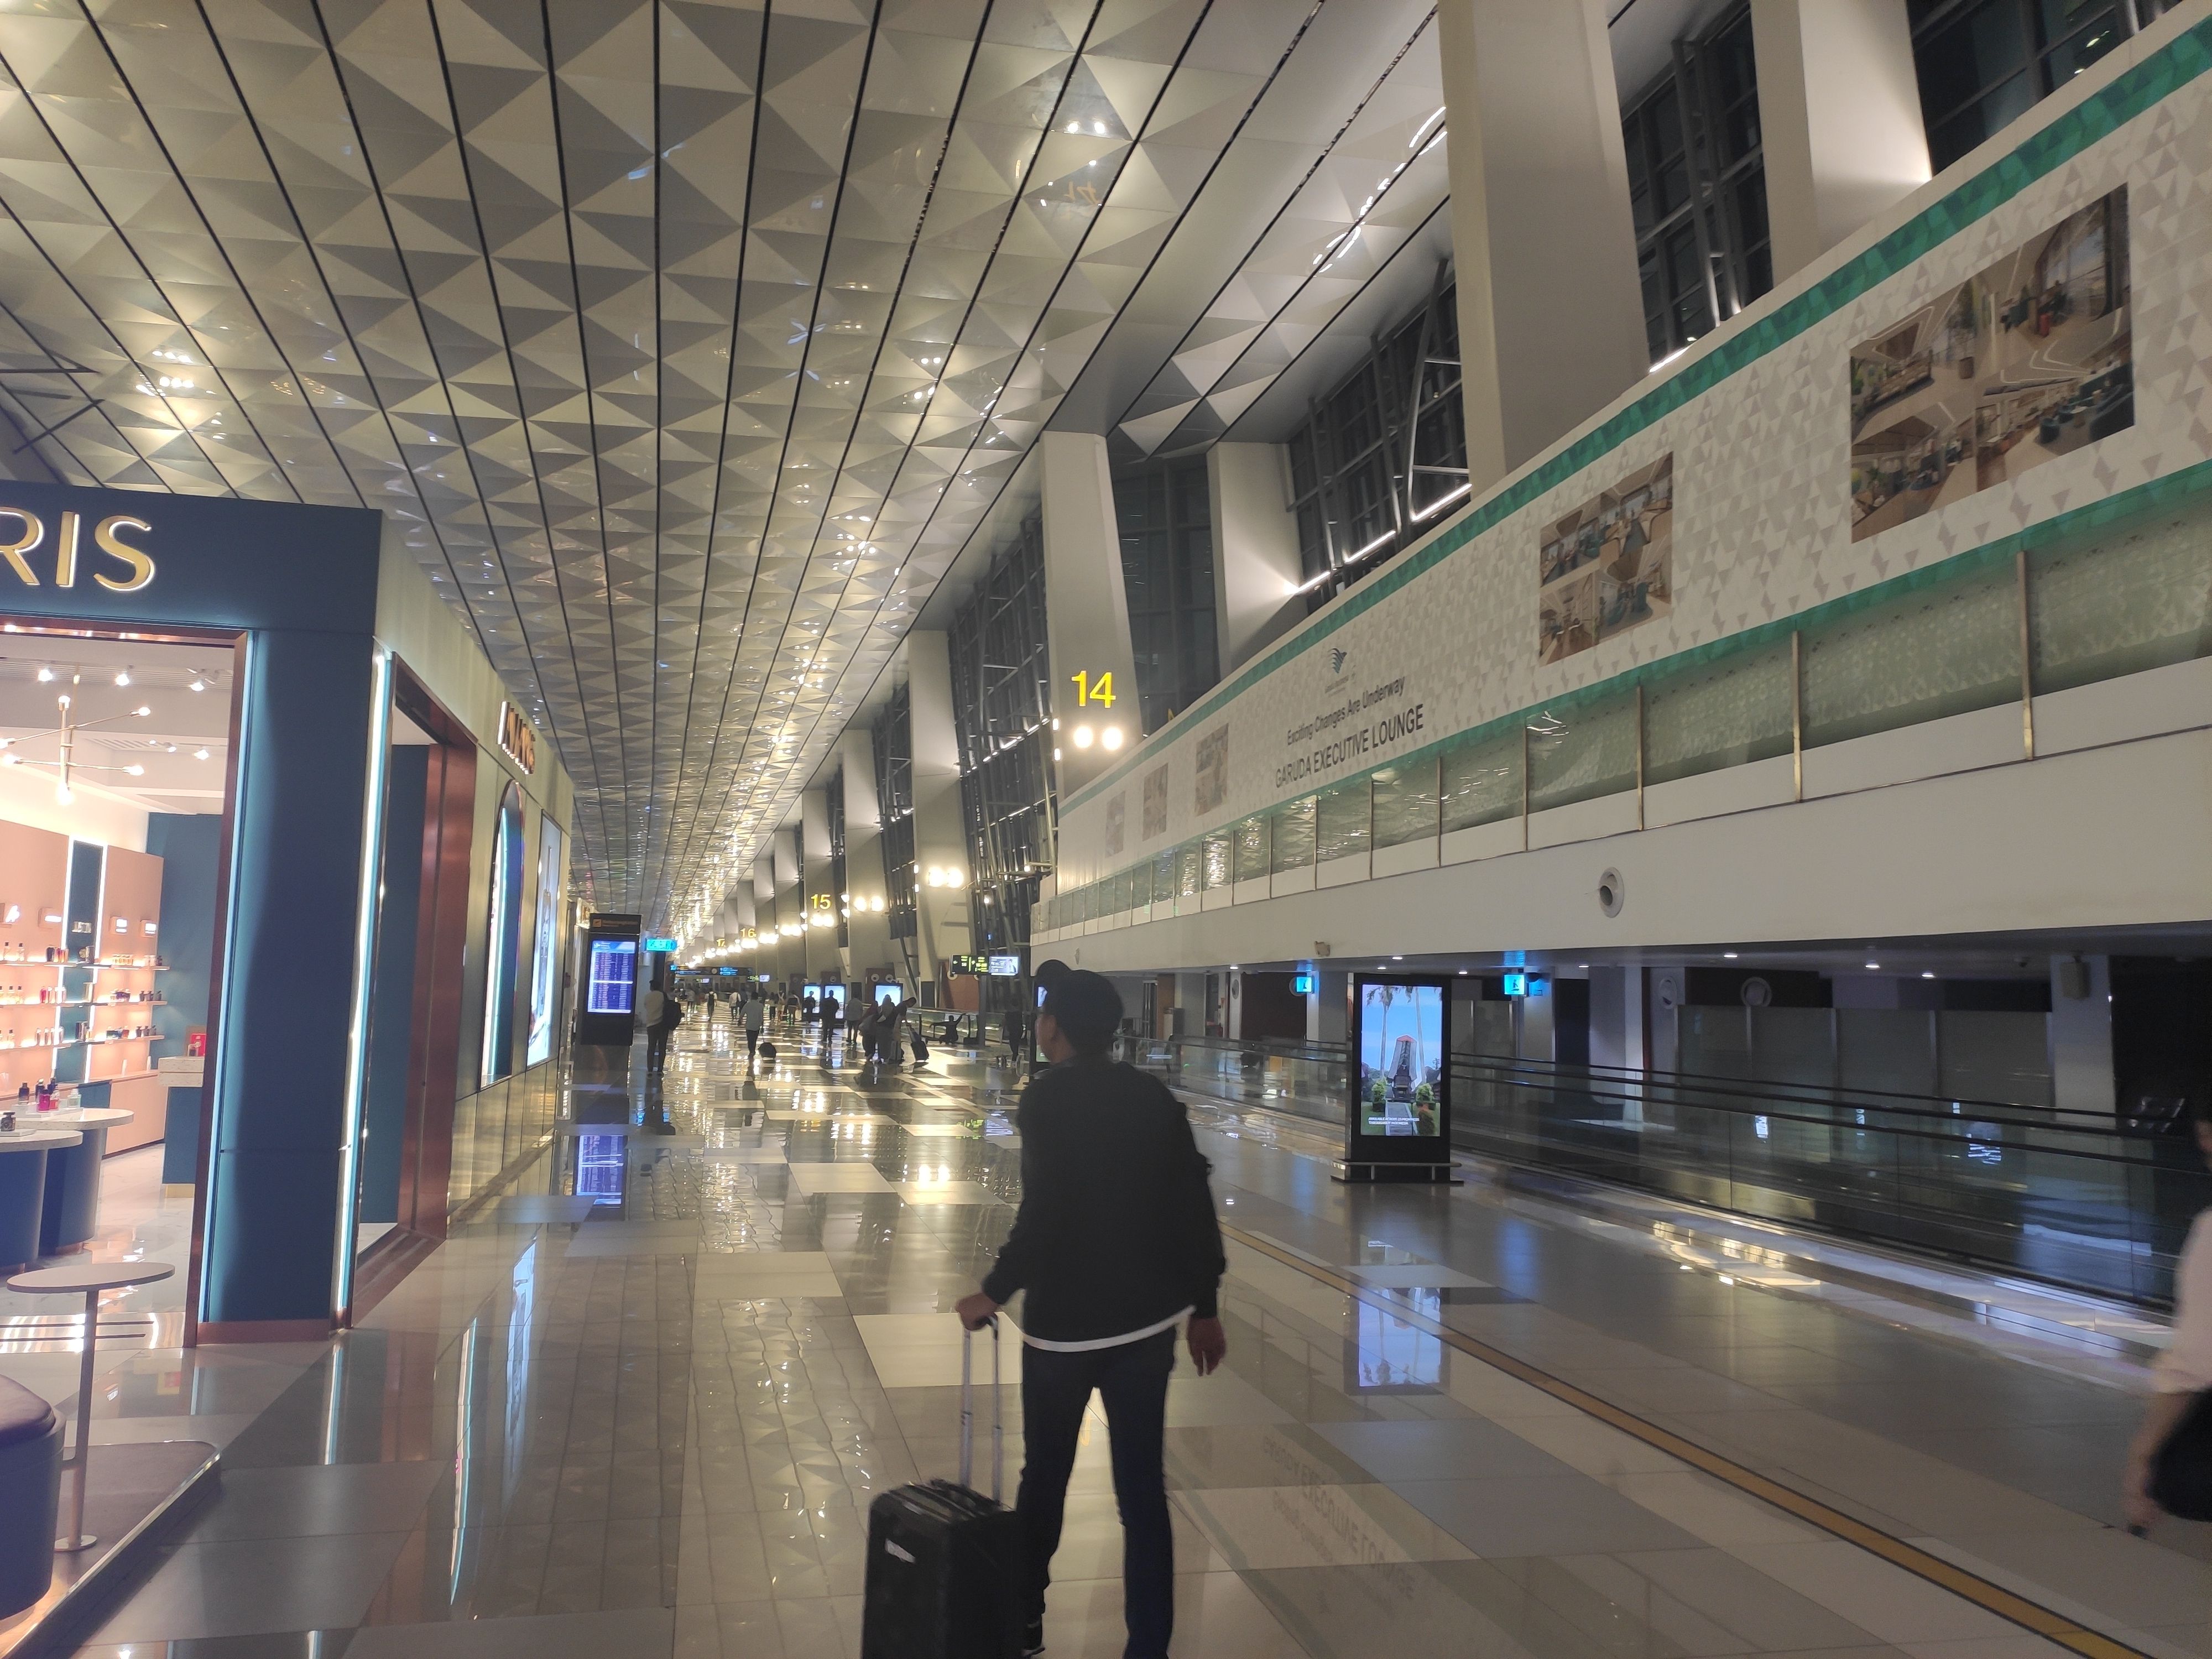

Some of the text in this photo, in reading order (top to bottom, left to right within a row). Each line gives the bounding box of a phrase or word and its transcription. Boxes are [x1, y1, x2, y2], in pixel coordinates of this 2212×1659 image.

[1071, 670, 1117, 708] 14
[1287, 723, 1313, 745] Exciting
[1314, 707, 1345, 733] Changes
[1347, 699, 1361, 717] Are
[1362, 676, 1405, 709] Underway
[1275, 703, 1423, 788] GARUDA EXECUTIVE LOUNGE
[810, 894, 832, 910] 15
[740, 928, 755, 938] 16
